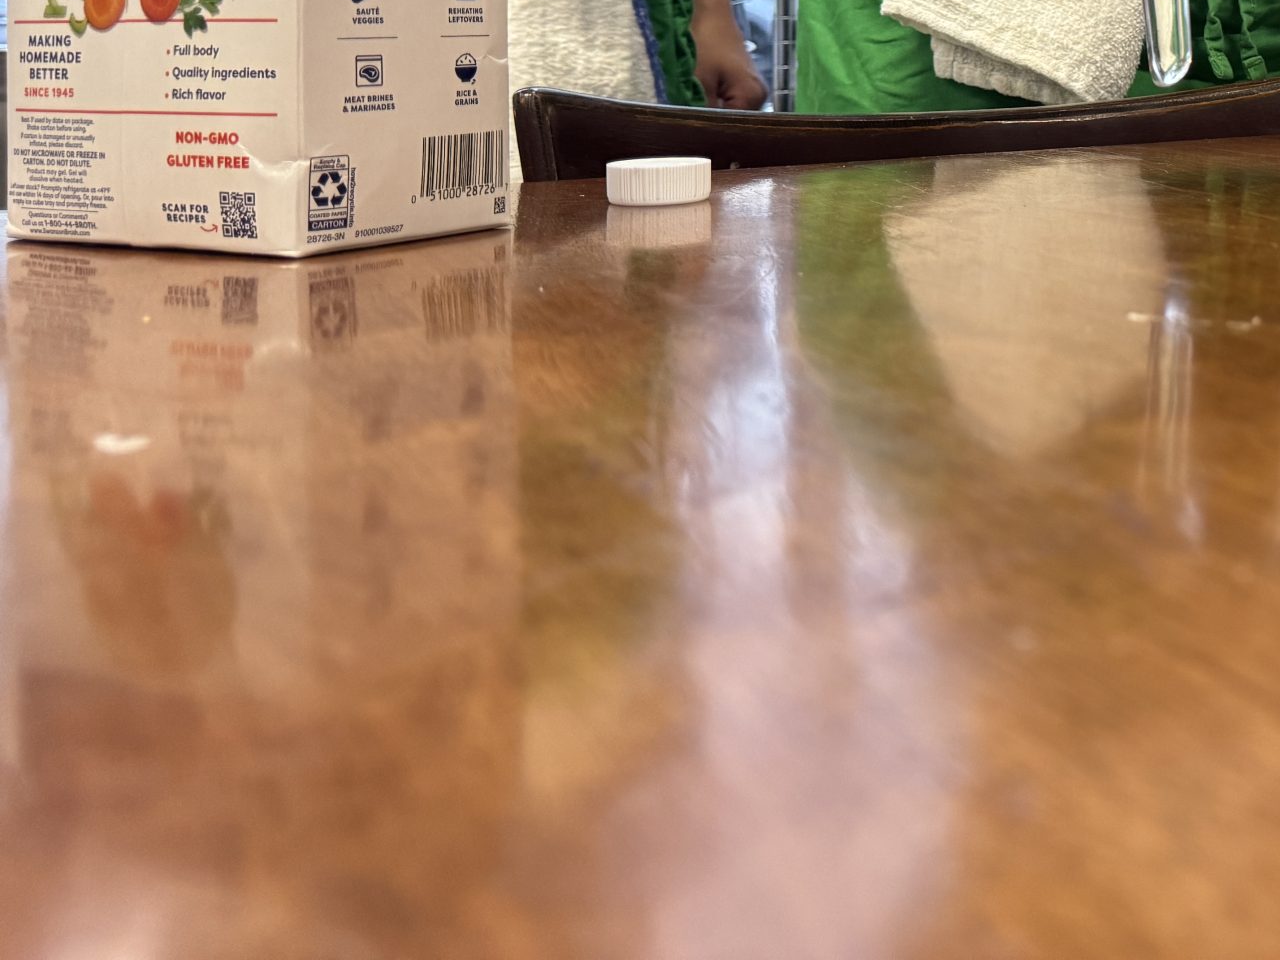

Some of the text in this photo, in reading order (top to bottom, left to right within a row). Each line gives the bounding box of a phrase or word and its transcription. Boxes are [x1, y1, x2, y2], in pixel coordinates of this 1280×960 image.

[356, 6, 380, 15] SAUTÉ
[28, 35, 72, 46] MAKING
[174, 44, 219, 59] Full body
[20, 52, 82, 63] HOMEMADE
[30, 68, 68, 80] BETTER
[172, 66, 276, 81] Quality ingredients
[24, 88, 74, 98] SINCE 1945
[172, 88, 226, 100] Rich flavor
[344, 94, 394, 104] MEAT BRINES
[455, 98, 478, 106] GRAINS
[350, 103, 395, 112] MARINADES
[176, 132, 239, 145] NON-GMO
[166, 154, 250, 168] GLUTEN FREE
[412, 184, 496, 204] 0 51000 28726
[162, 204, 208, 214] SCAN FOR
[167, 214, 206, 223] RECIPES
[312, 220, 344, 230] CARTON
[306, 232, 345, 244] 28726-3N
